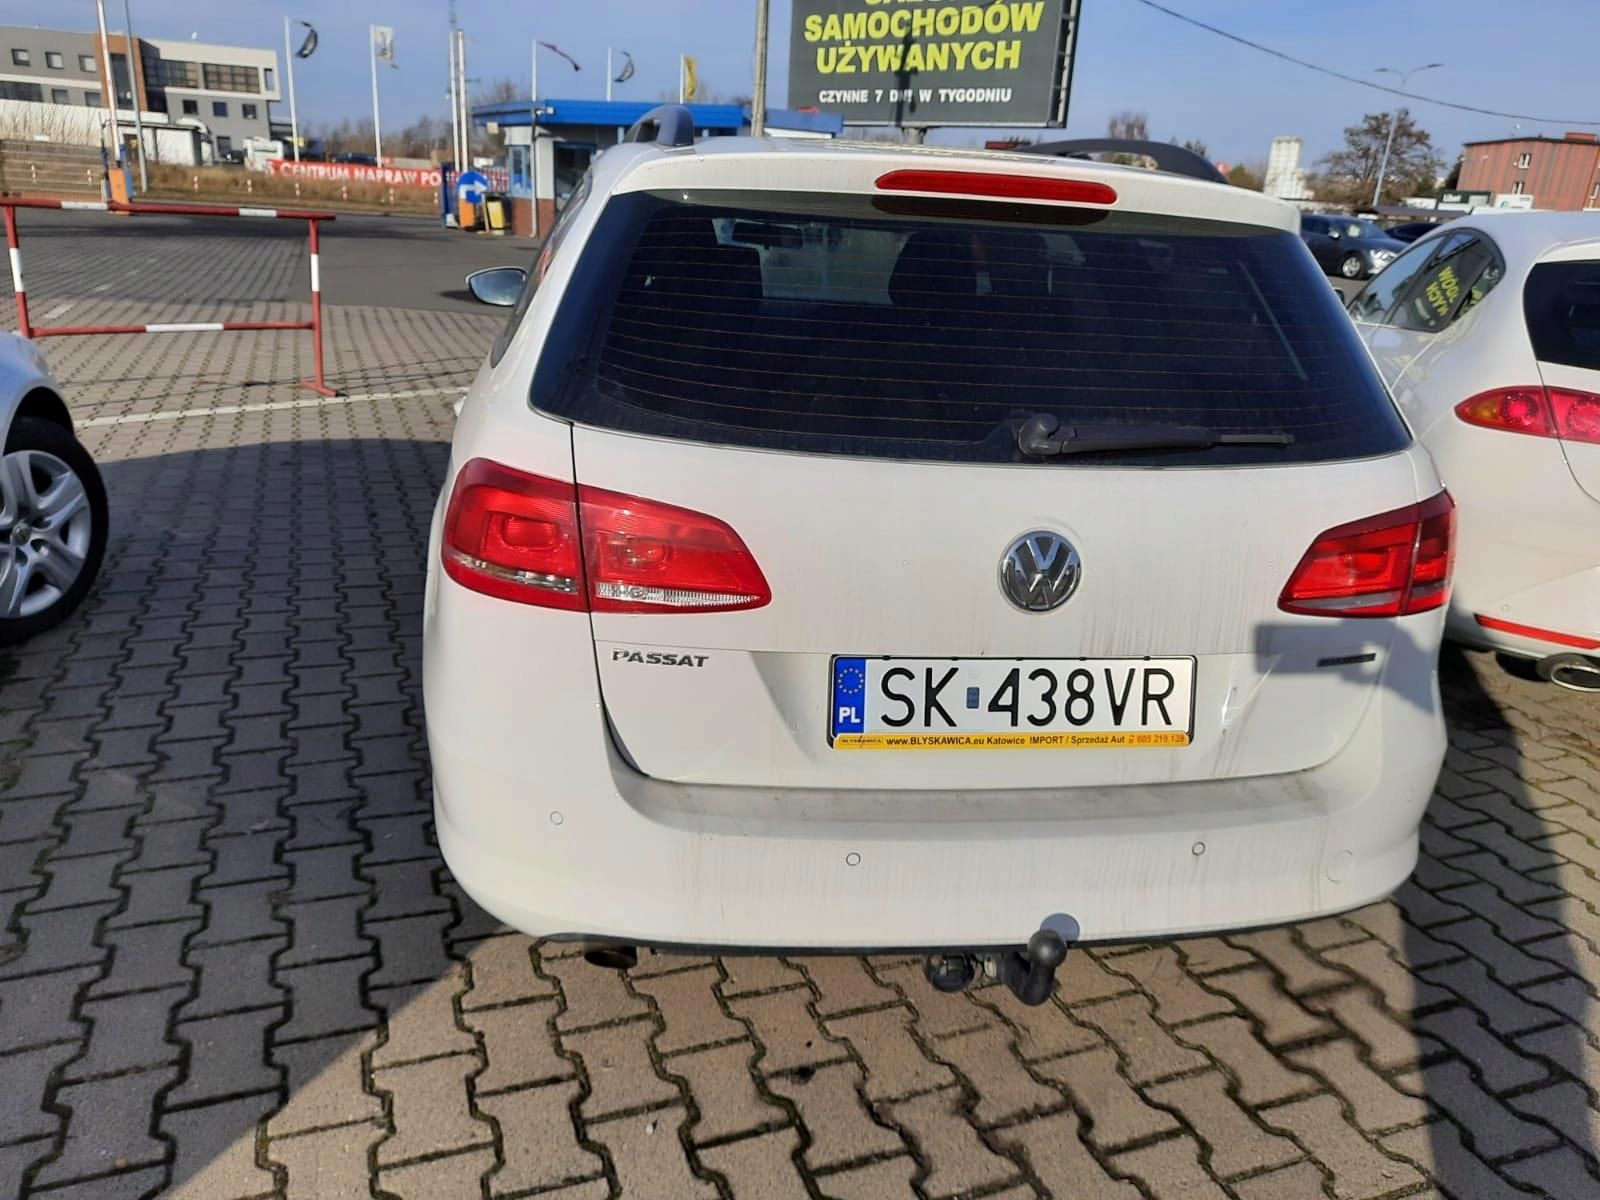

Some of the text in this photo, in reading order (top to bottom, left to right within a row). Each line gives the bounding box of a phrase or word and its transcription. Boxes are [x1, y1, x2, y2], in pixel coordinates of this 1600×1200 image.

[804, 1, 1045, 42] SAMOCHODÓW
[816, 40, 1022, 74] UŻYWANYCH
[819, 90, 869, 103] CZYNNE
[874, 89, 884, 103] 7
[919, 89, 933, 103] W
[939, 88, 1013, 103] TYGODNIU
[280, 163, 350, 181] CENTRUM
[354, 168, 417, 185] NAPRAW
[612, 650, 709, 668] PASSAT
[880, 667, 1175, 728] SK 438VR
[838, 707, 861, 723] PL
[986, 736, 1025, 745] Katowice
[1029, 736, 1064, 745] IMPORT
